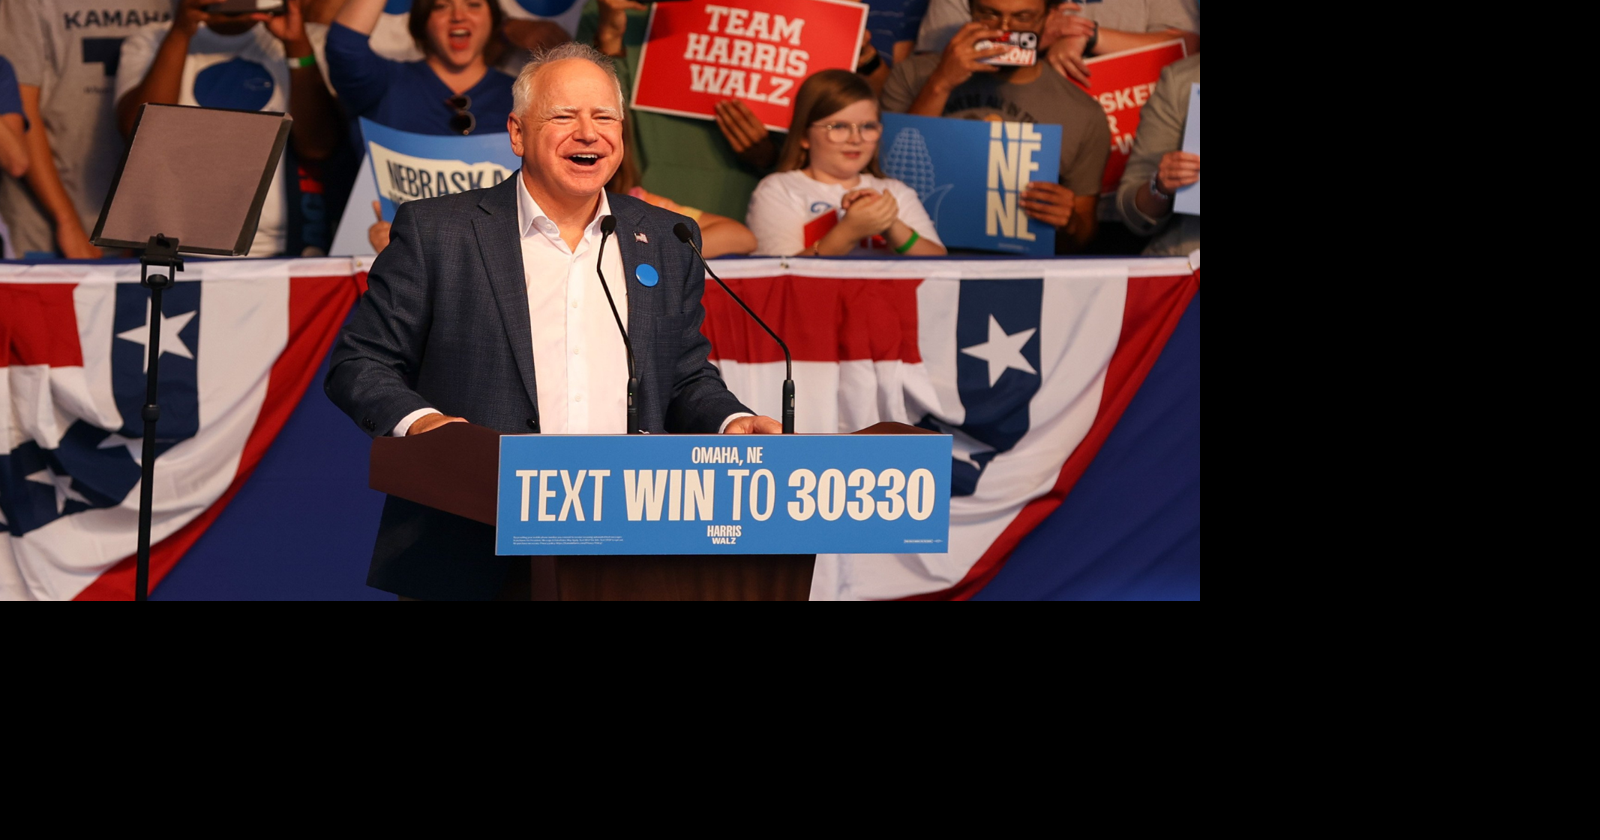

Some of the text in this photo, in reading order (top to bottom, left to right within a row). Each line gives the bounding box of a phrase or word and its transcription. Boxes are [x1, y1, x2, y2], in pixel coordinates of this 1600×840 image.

[705, 4, 805, 46] TEAM
[684, 32, 810, 78] HARRIS
[690, 63, 794, 107] WALZ
[1093, 81, 1156, 113] SKE
[692, 447, 763, 466] OMAHA, NE
[516, 468, 935, 521] TEXT WIN TO 30330
[707, 525, 741, 537] HARRIS
